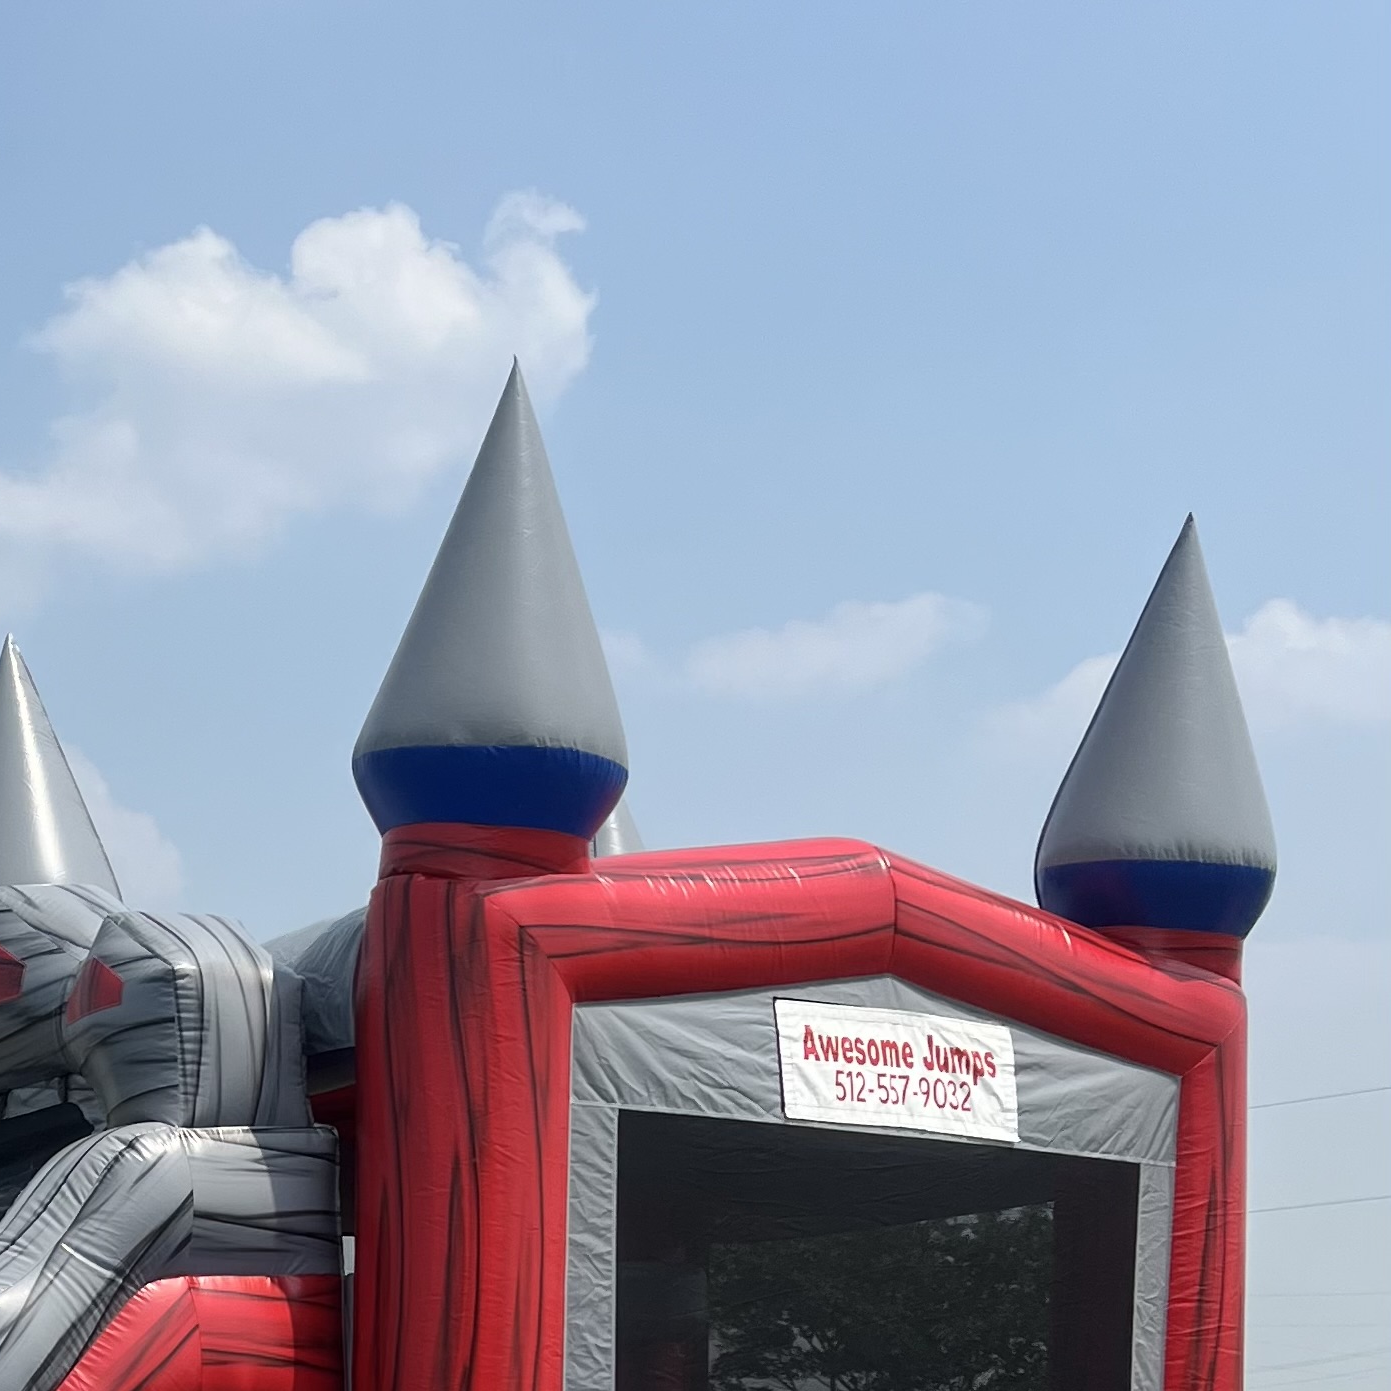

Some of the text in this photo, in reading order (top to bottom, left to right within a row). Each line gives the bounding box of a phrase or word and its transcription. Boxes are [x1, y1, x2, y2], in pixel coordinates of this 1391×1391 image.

[803, 1024, 996, 1086] Awesome Jumps
[835, 1070, 972, 1112] 512-557-9032
